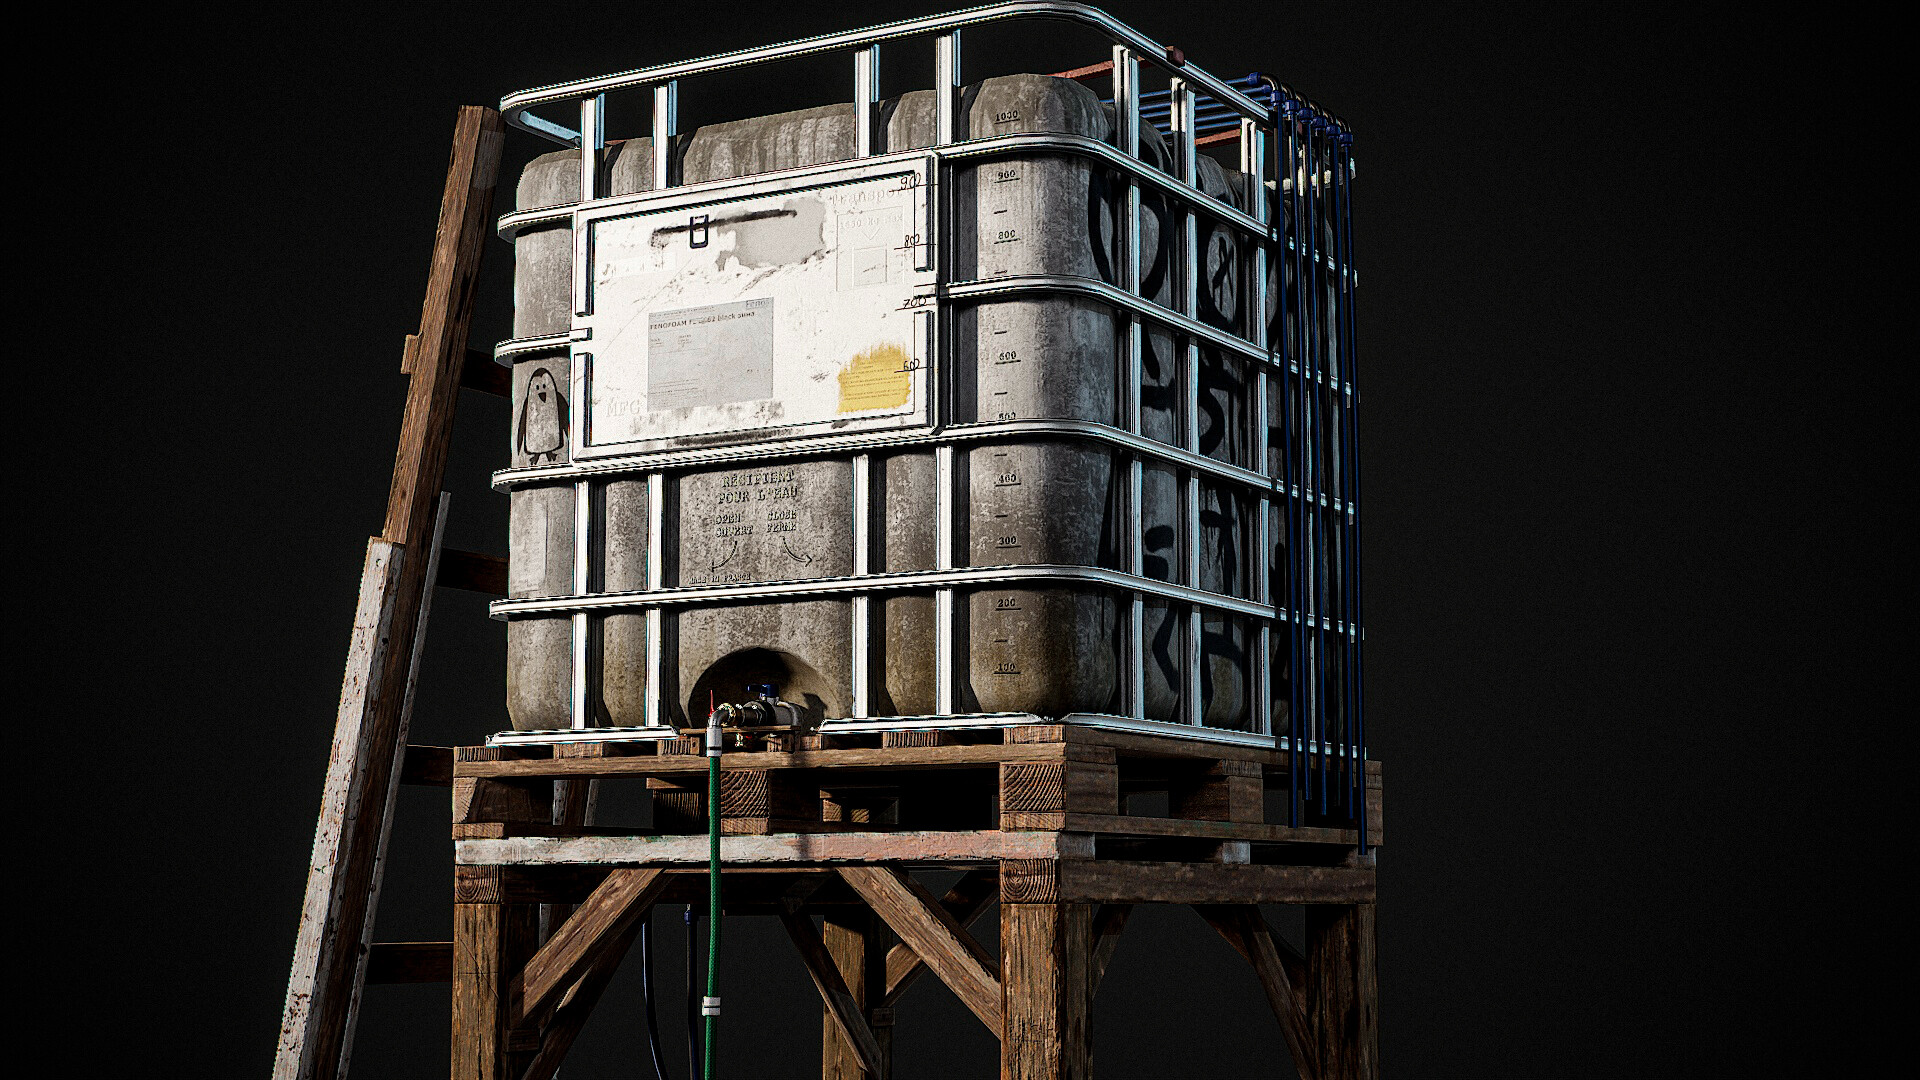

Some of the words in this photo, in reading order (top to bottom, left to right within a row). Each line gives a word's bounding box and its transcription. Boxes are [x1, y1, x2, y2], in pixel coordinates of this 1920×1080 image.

[995, 110, 1019, 121] 1000
[997, 169, 1016, 180] 900
[900, 172, 921, 190] 900
[904, 233, 920, 247] 800
[997, 229, 1016, 240] 800
[903, 297, 927, 308] 700
[999, 351, 1017, 361] 600
[903, 358, 920, 371] 600
[998, 473, 1017, 483] 400
[719, 490, 750, 504] POUR
[998, 535, 1017, 545] 300
[997, 598, 1016, 608] 200
[997, 662, 1016, 671] 100
